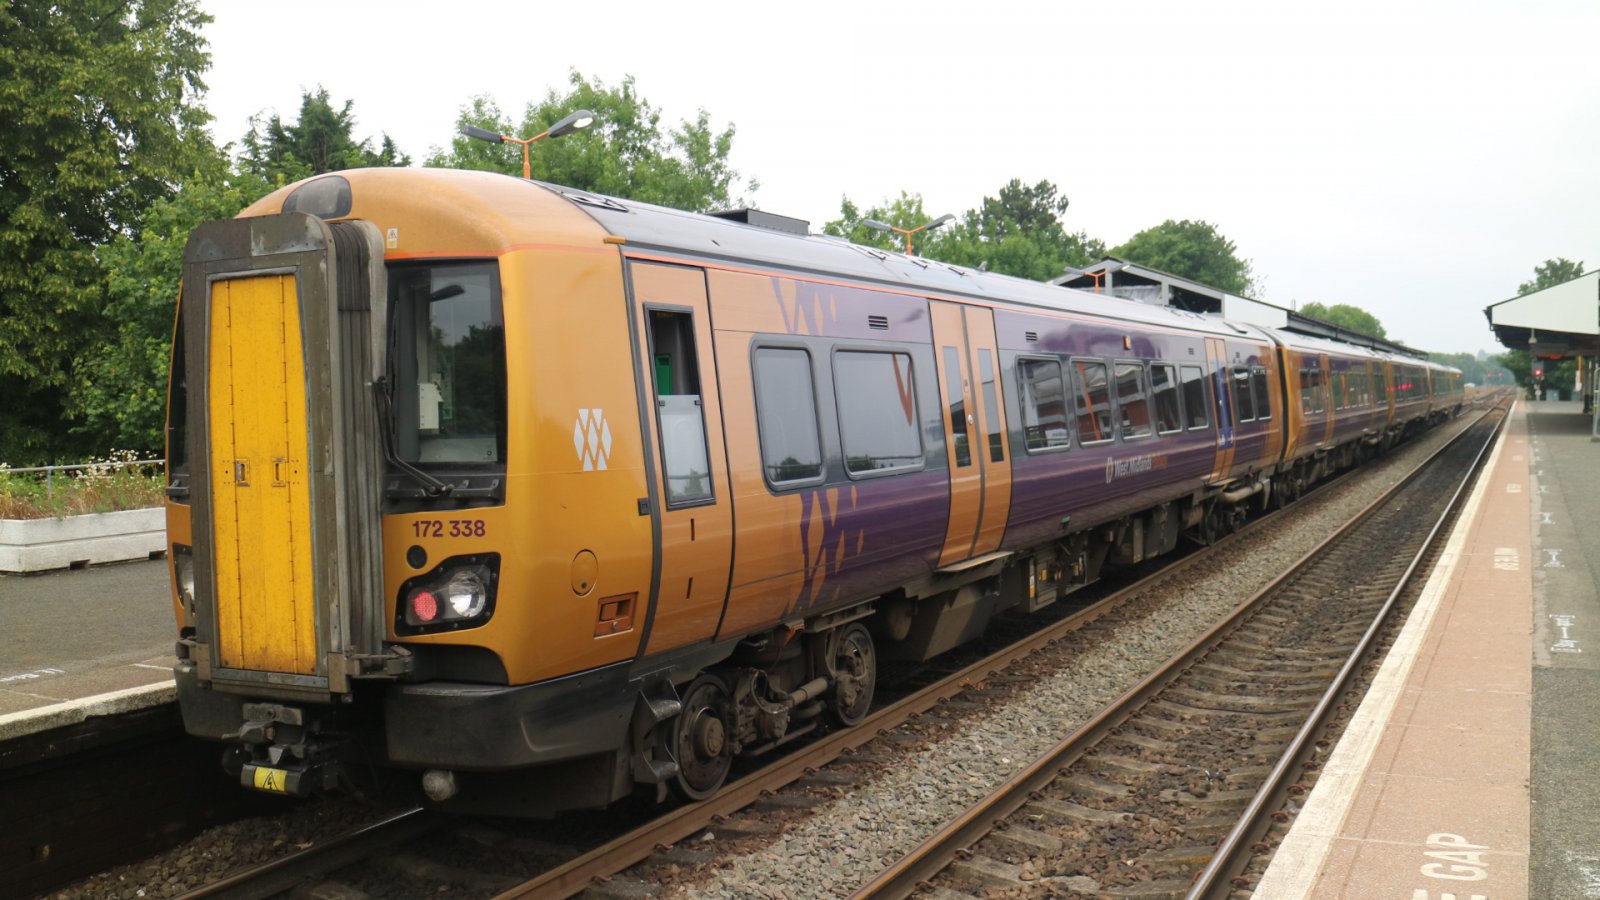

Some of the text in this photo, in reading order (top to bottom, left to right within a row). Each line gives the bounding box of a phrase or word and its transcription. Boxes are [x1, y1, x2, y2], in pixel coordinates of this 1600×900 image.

[412, 519, 486, 538] 172 338
[1420, 832, 1490, 881] GAP
